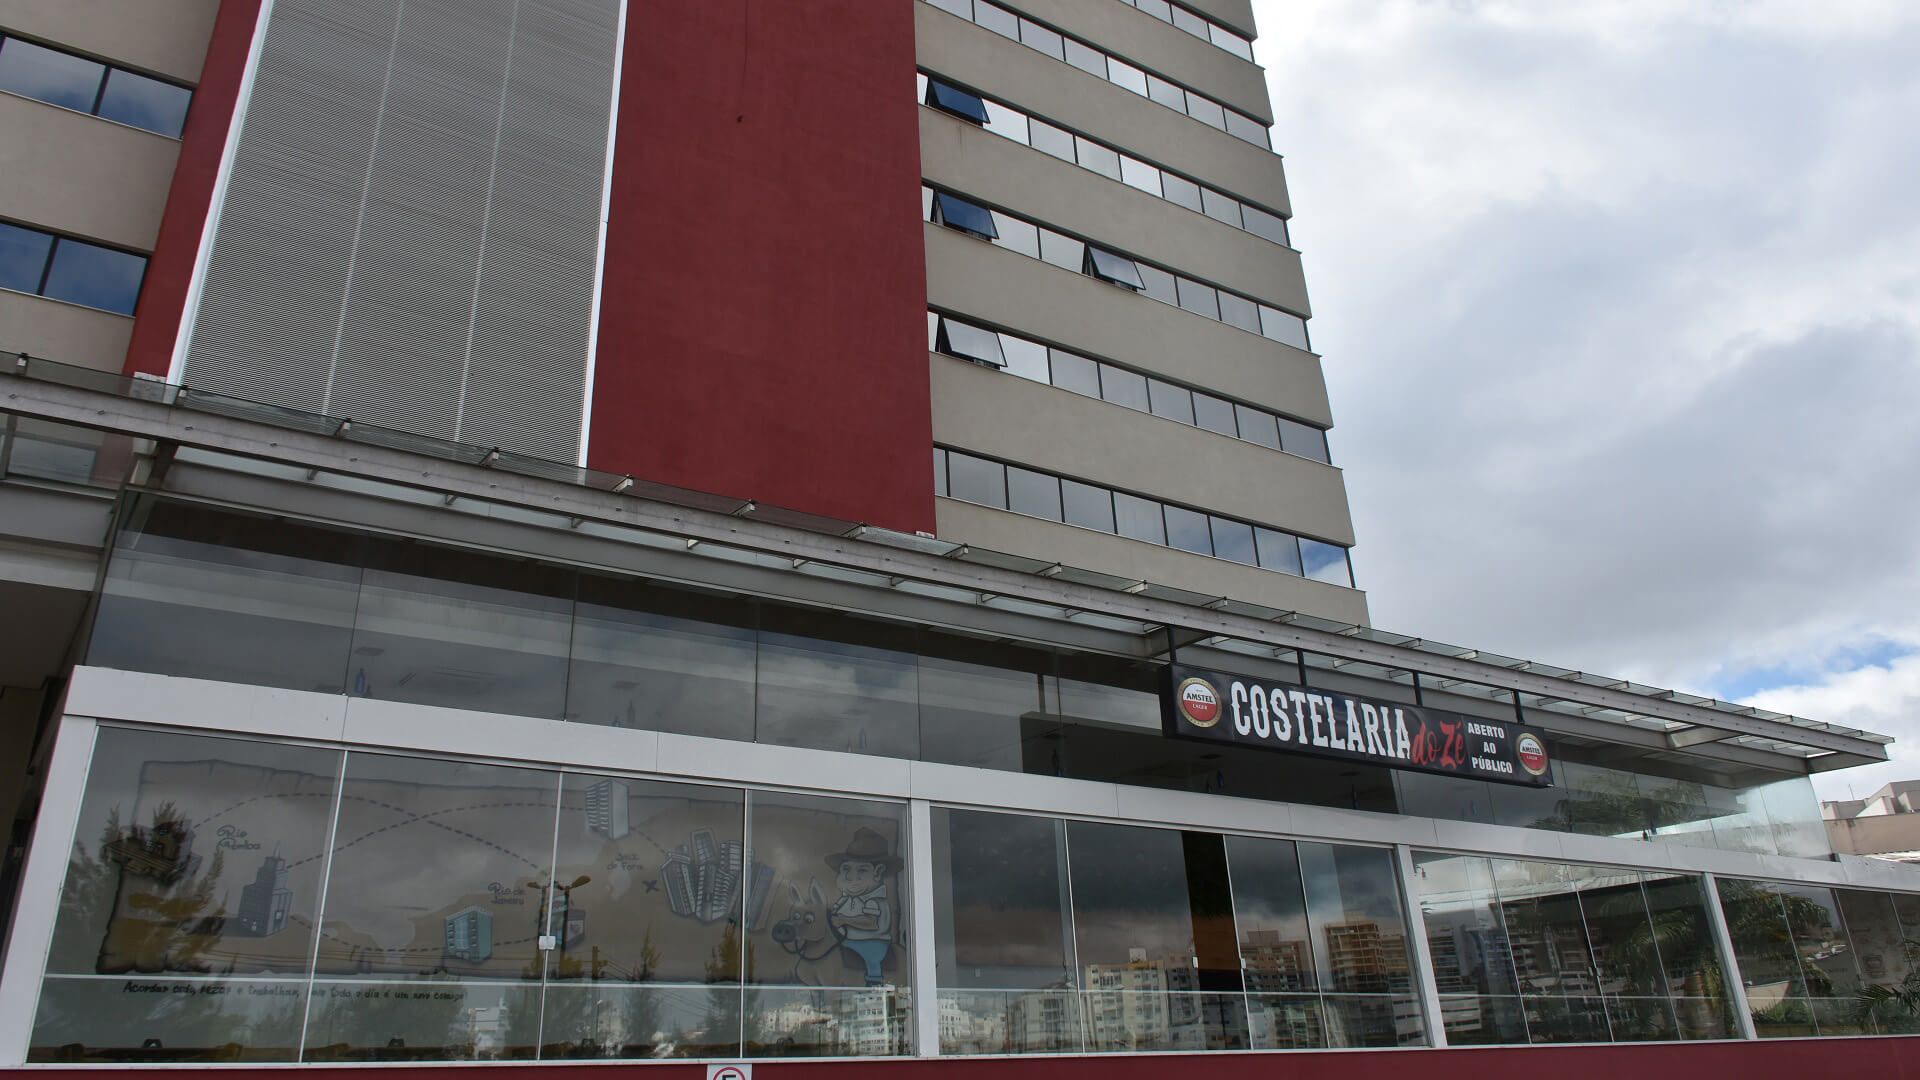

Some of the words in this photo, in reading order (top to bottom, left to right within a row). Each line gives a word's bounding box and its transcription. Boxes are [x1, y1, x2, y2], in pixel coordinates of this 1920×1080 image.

[1186, 692, 1213, 703] AMSTEL
[1231, 681, 1411, 760] COSTELARIA
[1412, 721, 1440, 766] do
[1440, 720, 1465, 770] Zé
[1468, 722, 1505, 739] ABERTO
[1484, 741, 1497, 754] AO
[1471, 755, 1513, 774] PÚBLICO
